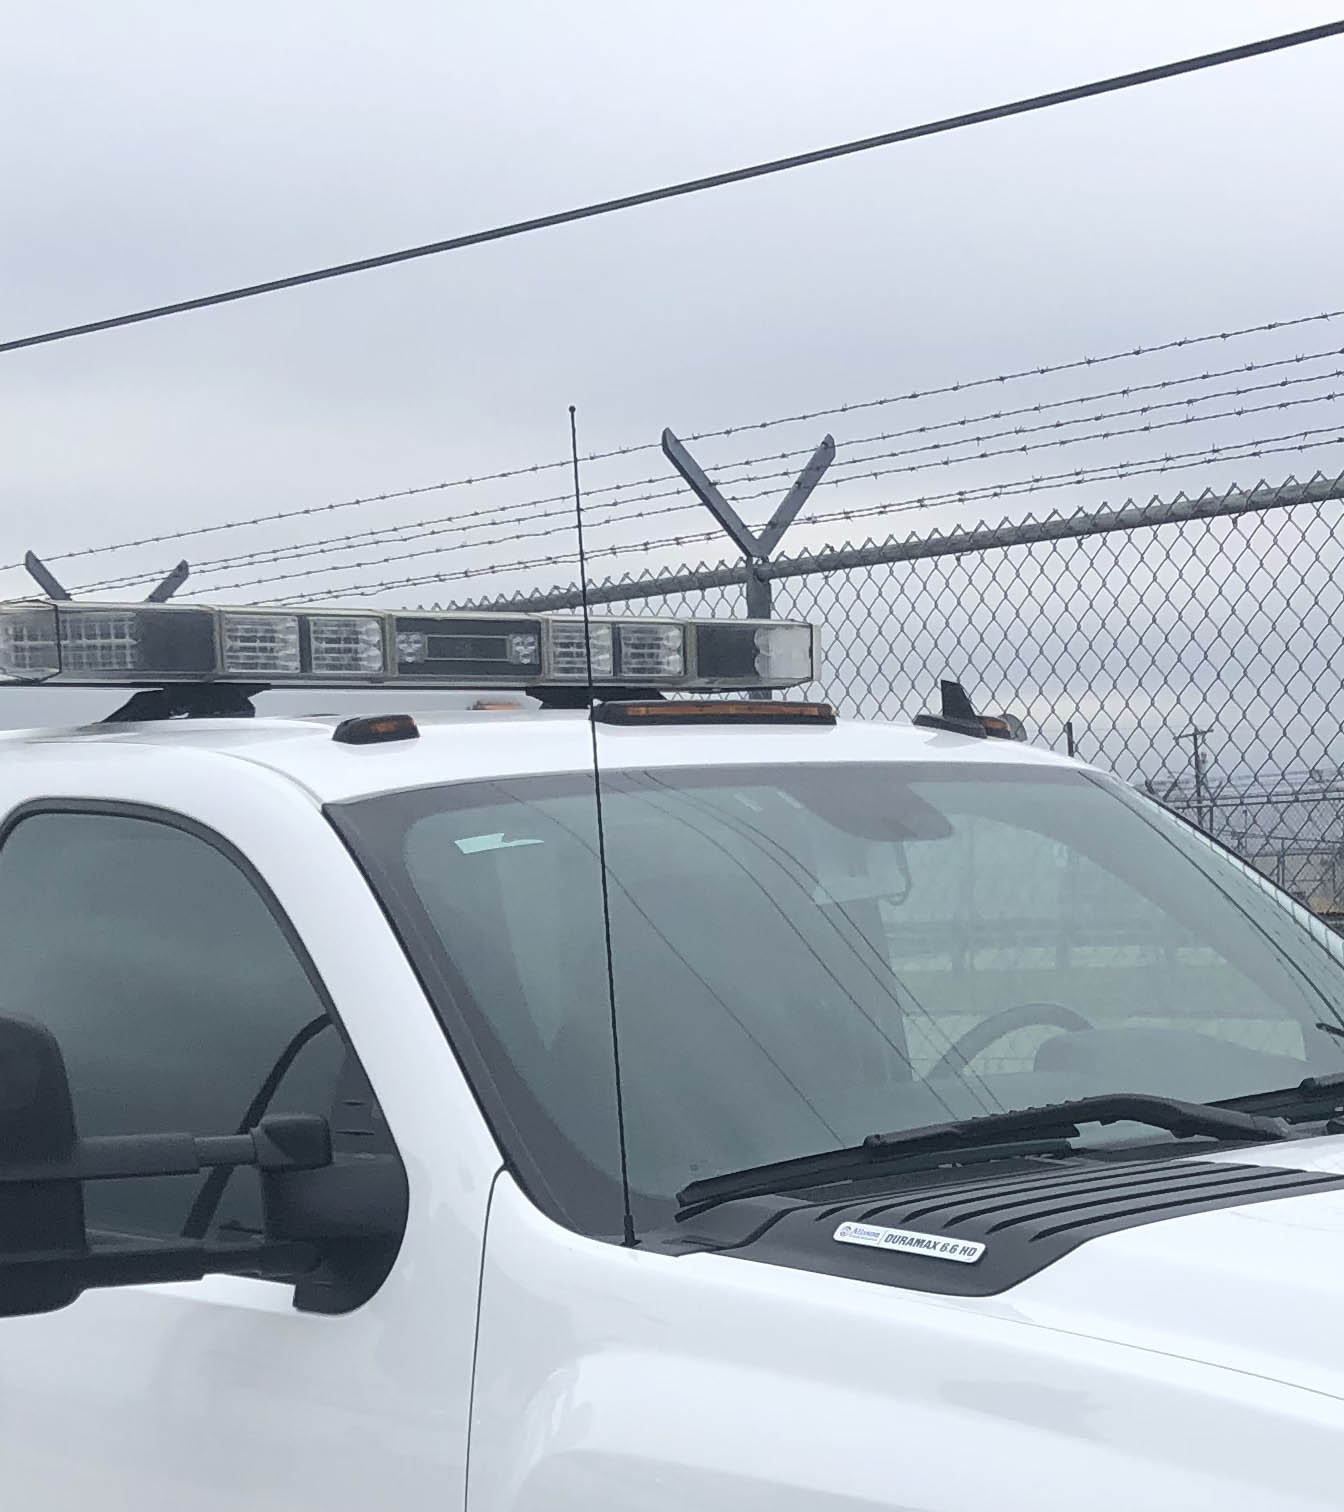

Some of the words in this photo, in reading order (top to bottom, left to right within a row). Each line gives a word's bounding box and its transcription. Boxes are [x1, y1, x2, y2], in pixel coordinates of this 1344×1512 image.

[884, 1233, 941, 1251] DURAMAX
[939, 1242, 960, 1254] 6.6
[959, 1245, 978, 1257] HD
